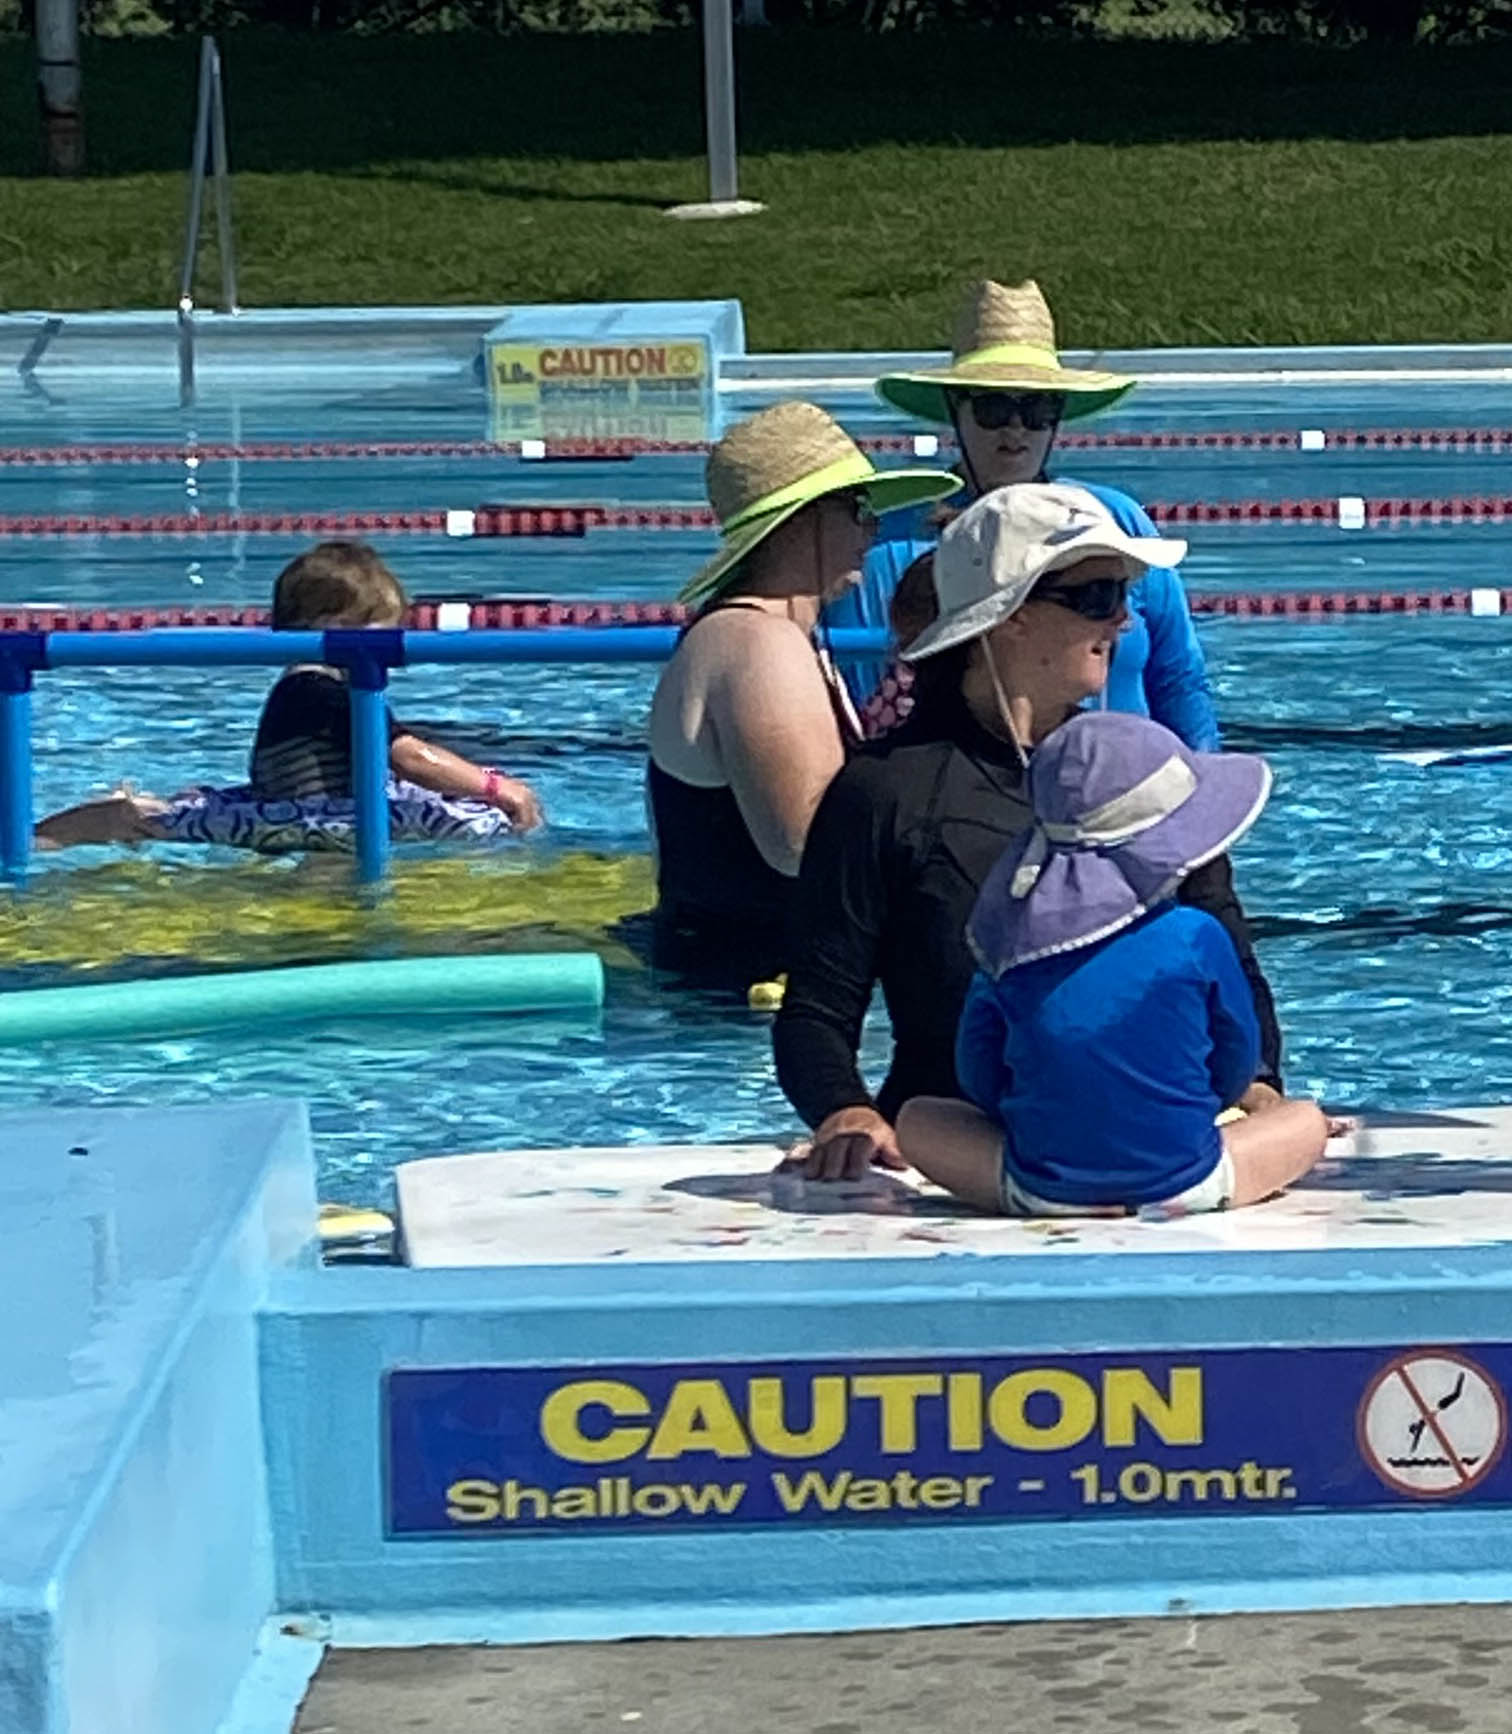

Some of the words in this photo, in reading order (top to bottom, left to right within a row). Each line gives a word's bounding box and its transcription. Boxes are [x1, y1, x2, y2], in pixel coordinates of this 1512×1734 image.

[538, 347, 666, 376] CAUTION
[542, 1367, 1202, 1463] CAUTION
[446, 1477, 747, 1522] Shallow
[771, 1471, 994, 1512] Water
[1019, 1480, 1044, 1491] -
[1070, 1462, 1297, 1503] 1.0mtr.
